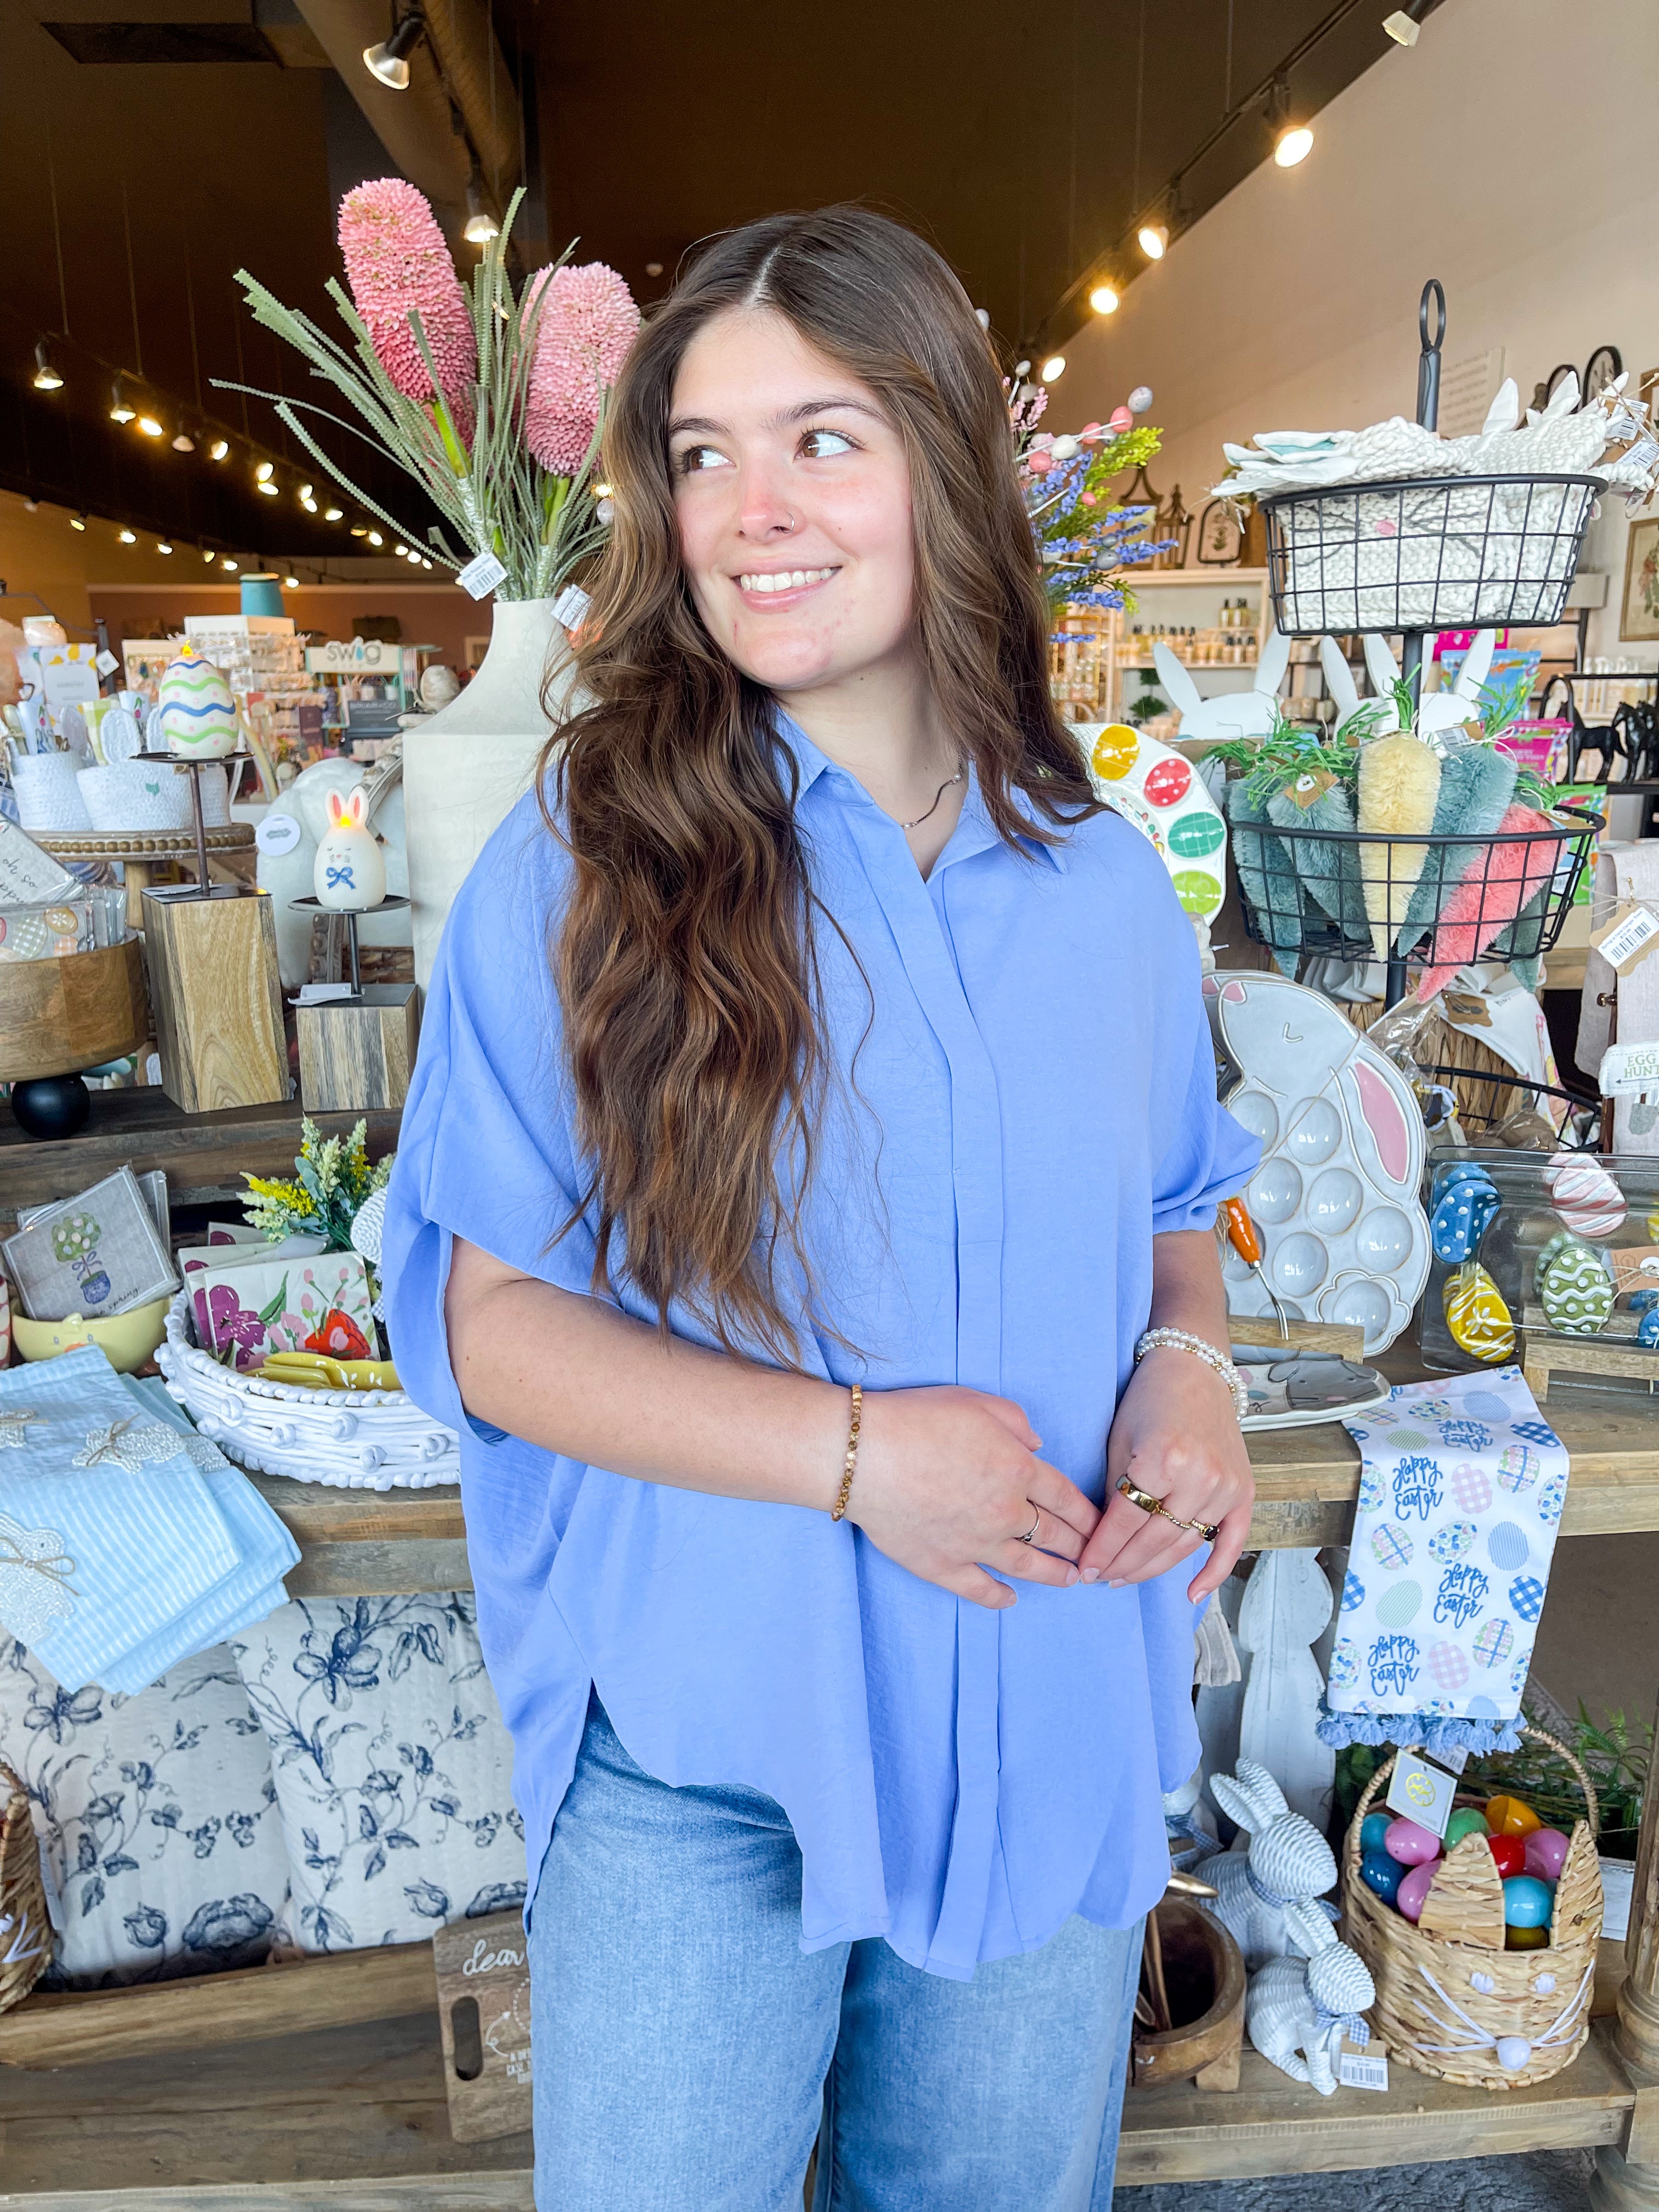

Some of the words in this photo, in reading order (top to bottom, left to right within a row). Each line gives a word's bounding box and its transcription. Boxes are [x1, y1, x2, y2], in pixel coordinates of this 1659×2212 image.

[1624, 1065, 1659, 1078] HUNT
[1627, 1053, 1656, 1067] EGG
[1395, 1485, 1444, 1521] Easter
[1434, 1593, 1483, 1629] Easter
[1370, 1661, 1420, 1696] Easter
